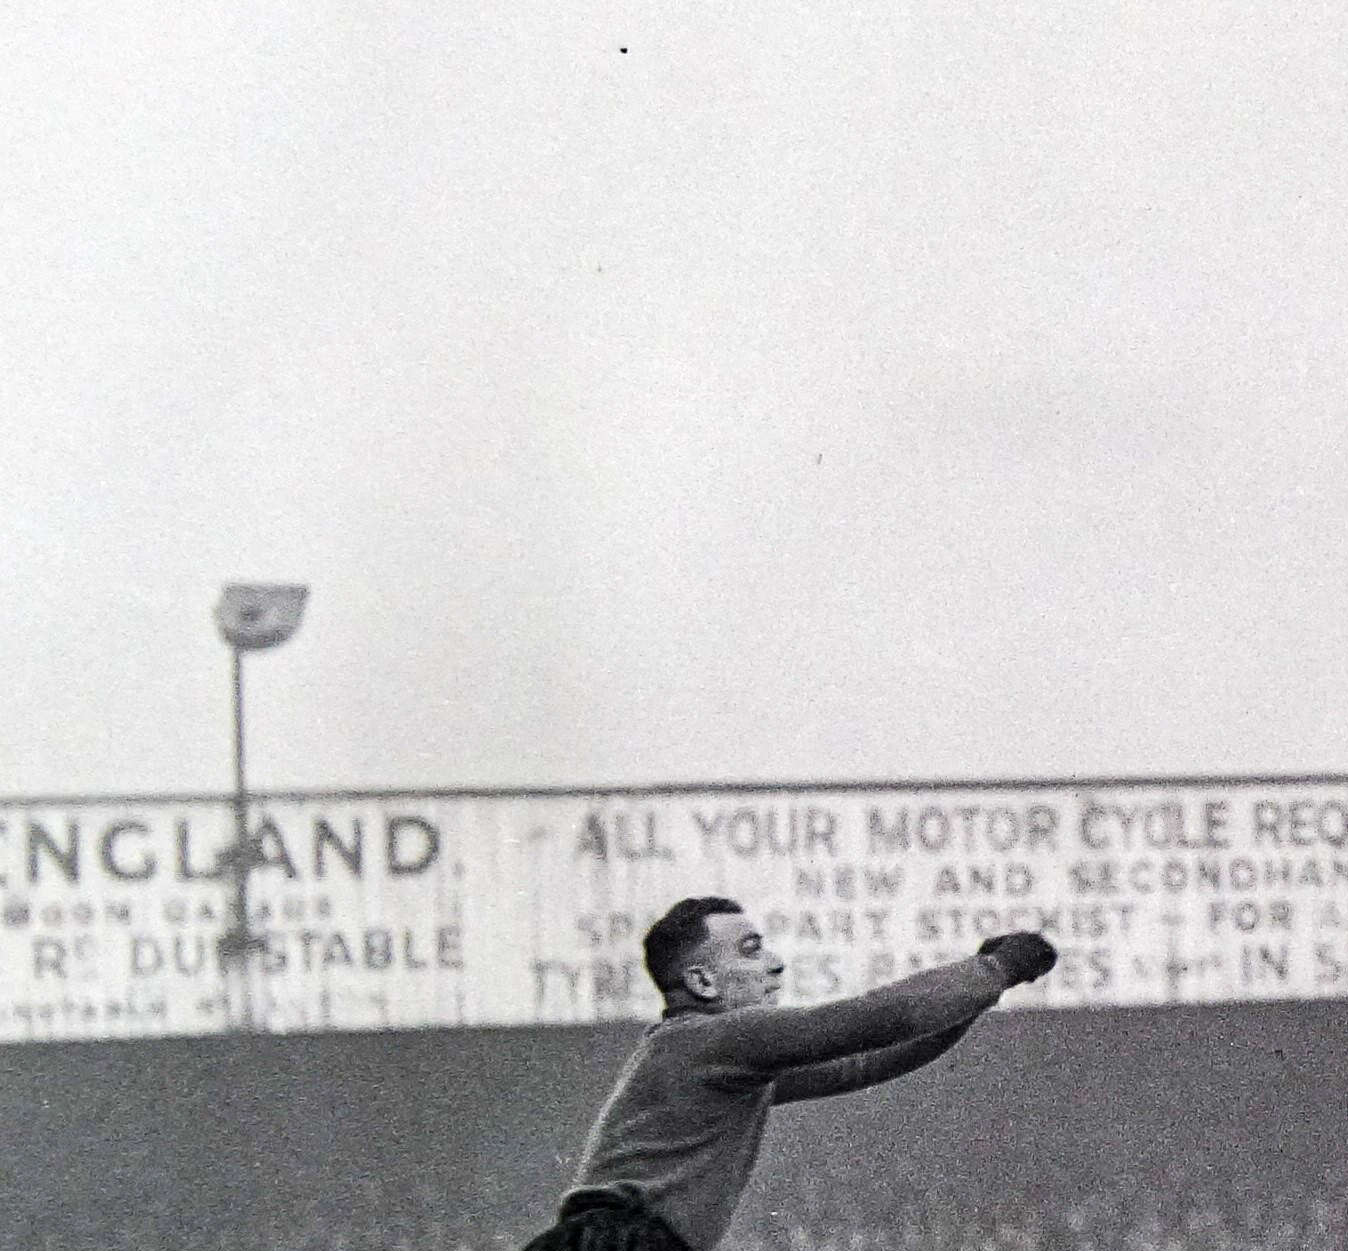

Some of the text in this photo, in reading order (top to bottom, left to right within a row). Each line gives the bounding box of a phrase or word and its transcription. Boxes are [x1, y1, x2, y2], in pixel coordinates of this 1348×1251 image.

[574, 810, 674, 862] ALL
[693, 806, 838, 857] YOUR
[865, 803, 1059, 856] MOTOR
[1080, 799, 1231, 850] CYCLE
[797, 865, 905, 900] NEW
[934, 863, 1035, 896] AND
[766, 908, 888, 944] PART
[915, 903, 1135, 942] STOCKIST
[1209, 899, 1293, 933] FOR
